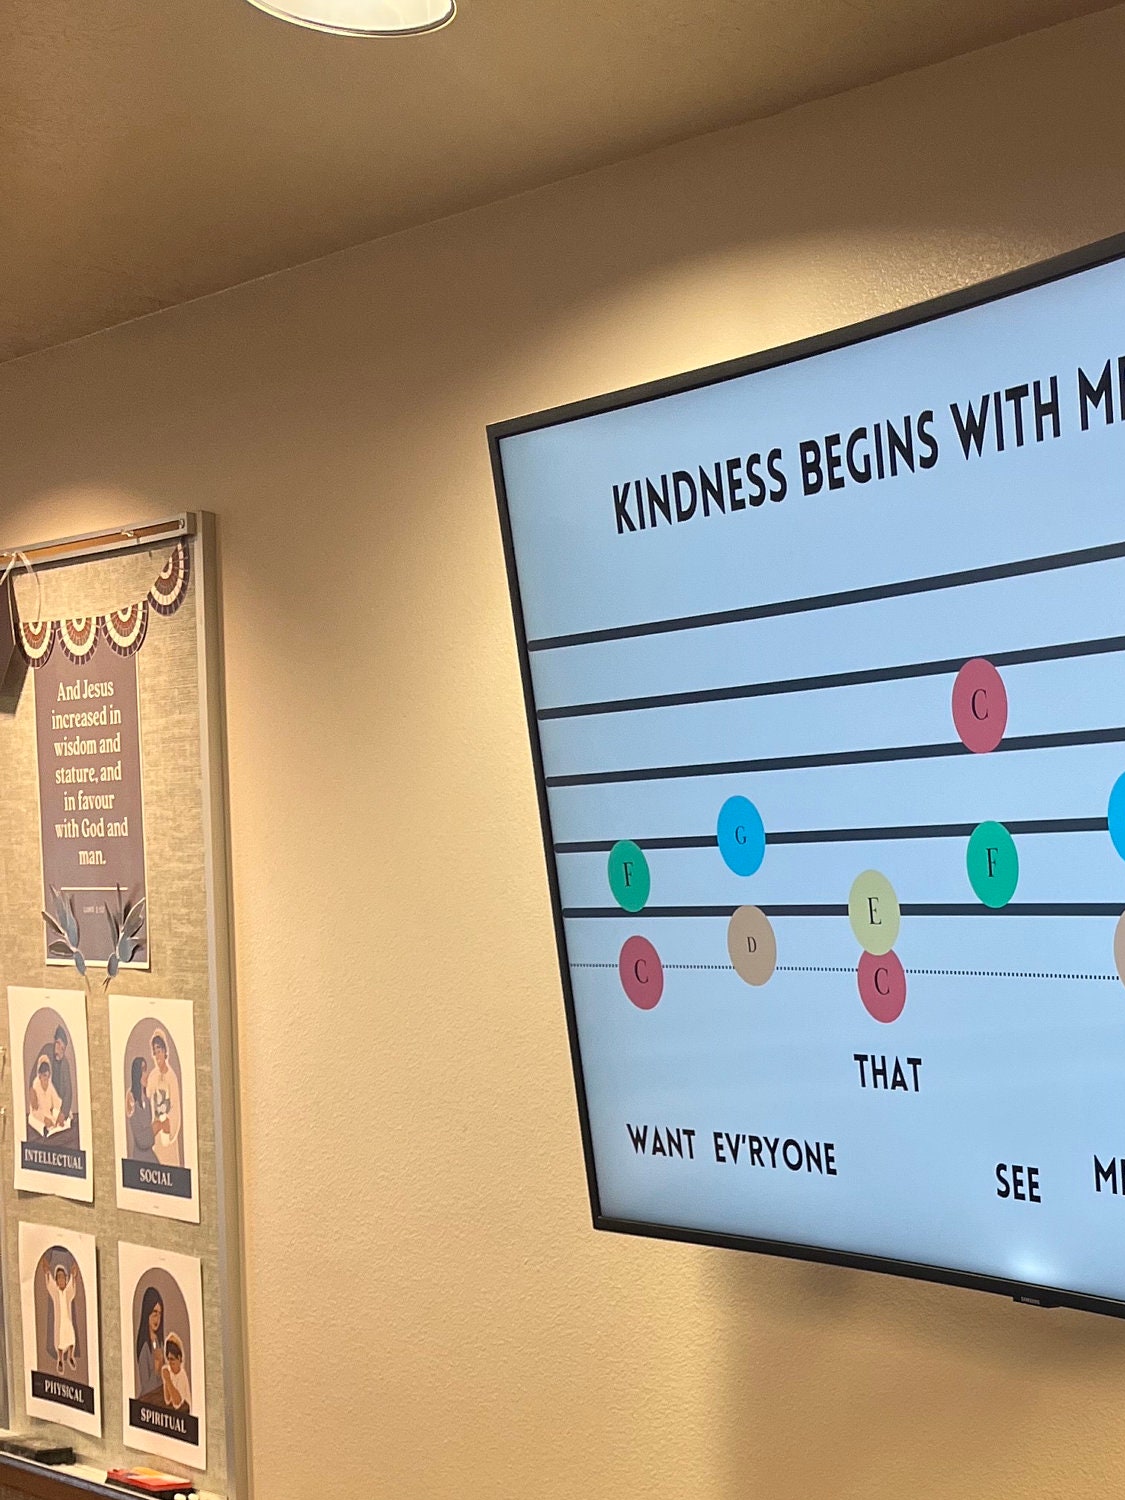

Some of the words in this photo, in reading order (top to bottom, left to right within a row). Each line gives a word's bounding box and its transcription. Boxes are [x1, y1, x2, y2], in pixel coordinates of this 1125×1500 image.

[612, 448, 788, 535] KINDNESS
[799, 410, 939, 496] BEGINS
[949, 375, 1061, 461] WITH
[57, 679, 81, 702] And
[83, 679, 114, 699] Jesus
[52, 705, 108, 730] increased
[110, 705, 122, 725] in
[971, 689, 989, 721] C
[54, 735, 97, 757] wisdom
[99, 732, 121, 754] and
[55, 766, 98, 784] stature,
[100, 761, 122, 782] and
[64, 791, 76, 811] in
[78, 789, 115, 811] favour
[55, 817, 80, 838] with
[82, 817, 105, 838] God
[107, 816, 129, 837] and
[735, 826, 747, 845] G
[79, 850, 107, 865] man.
[986, 847, 999, 878] F
[623, 862, 634, 887] F
[867, 897, 882, 926] E
[747, 936, 757, 953] D
[634, 959, 649, 984] C
[874, 967, 891, 996] C
[853, 1053, 922, 1092] THAT
[24, 1148, 83, 1170] INTELLECTUAL
[626, 1123, 696, 1160] WANT
[713, 1131, 838, 1176] EV'RYONE
[139, 1168, 173, 1187] SOCIAL
[995, 1163, 1042, 1204] SEE
[44, 1379, 84, 1403] PHYSICAL
[140, 1407, 187, 1434] SPIRITUAL
